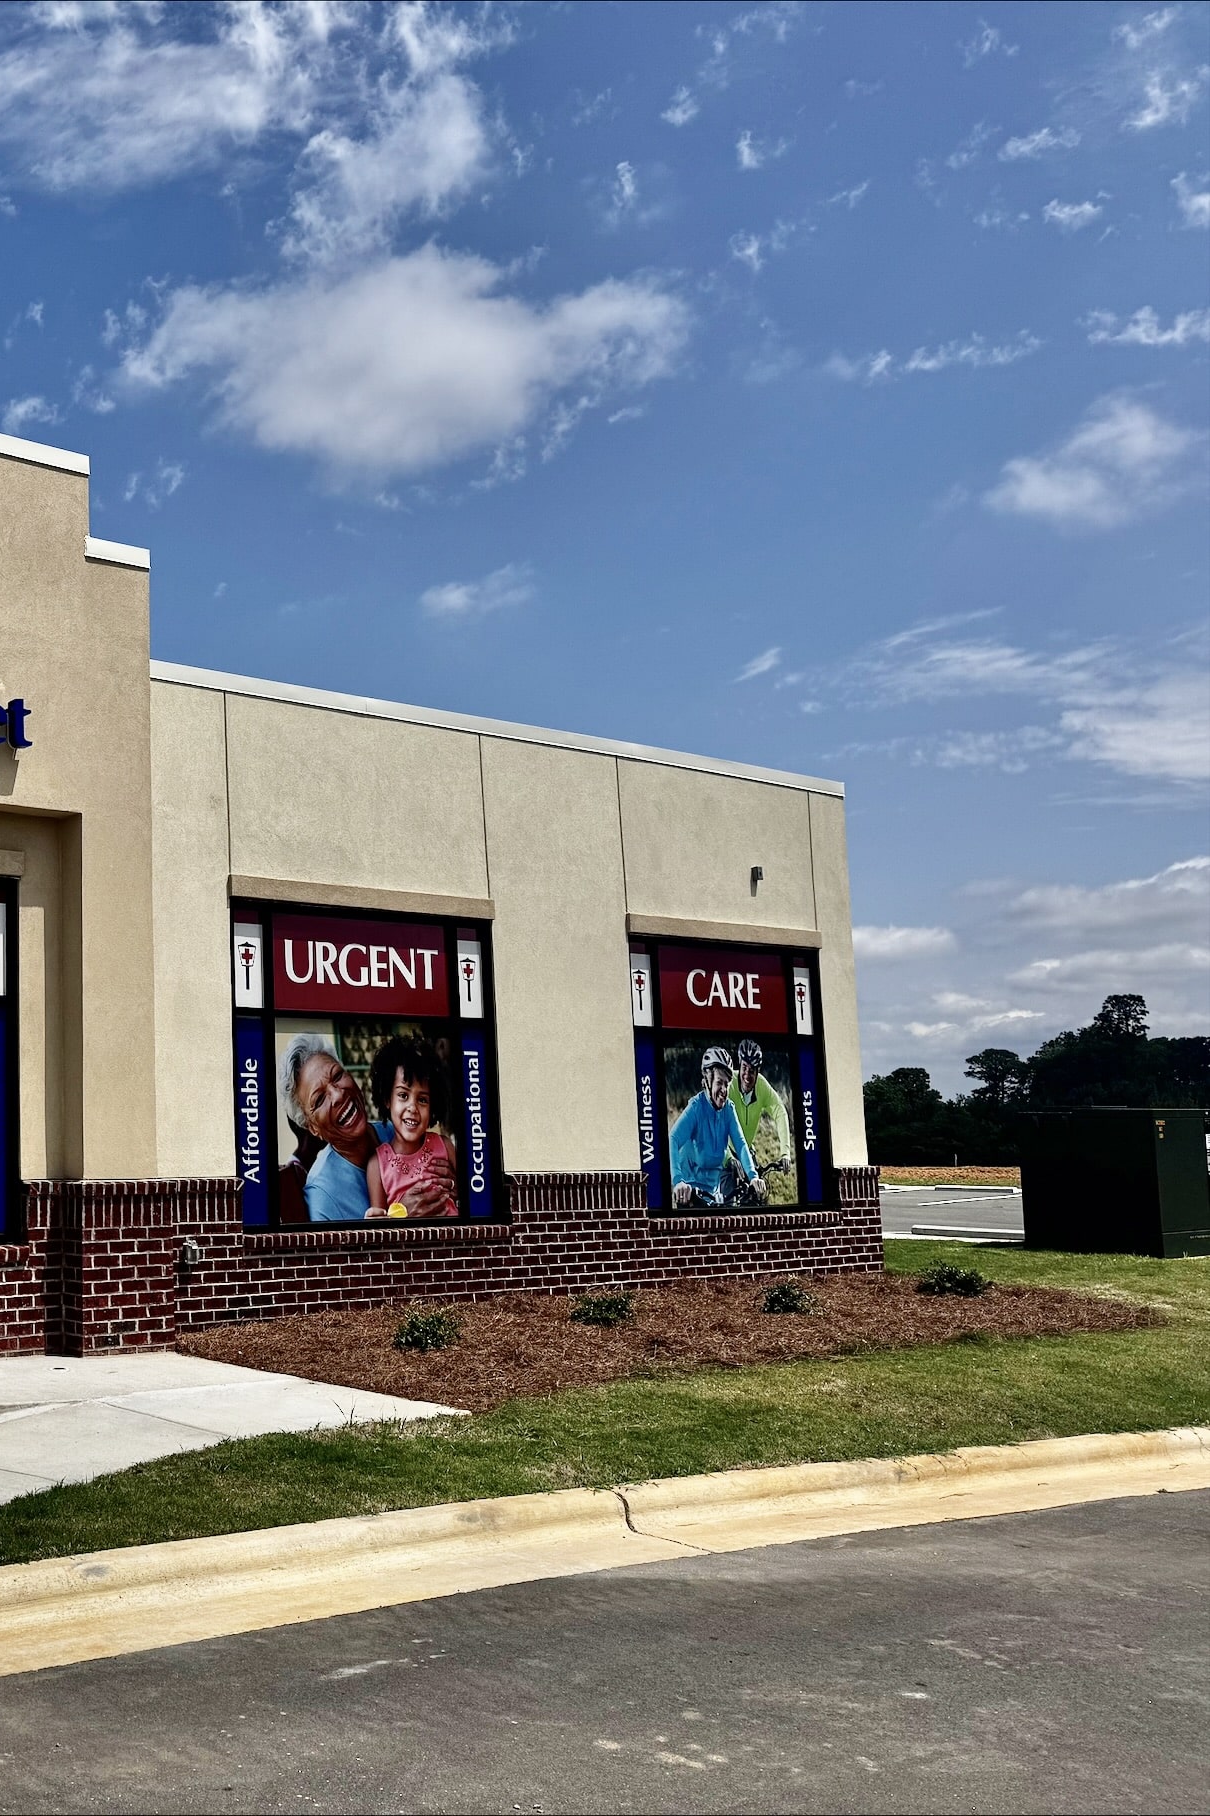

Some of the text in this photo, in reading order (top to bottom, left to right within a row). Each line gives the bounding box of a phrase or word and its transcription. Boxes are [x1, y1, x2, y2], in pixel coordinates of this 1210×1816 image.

[283, 938, 439, 990] URGENT
[685, 968, 762, 1010] CARE
[240, 1058, 261, 1184] Affordable
[463, 1050, 486, 1193] Occupational
[639, 1075, 656, 1164] Wellness
[802, 1090, 817, 1151] Sports
